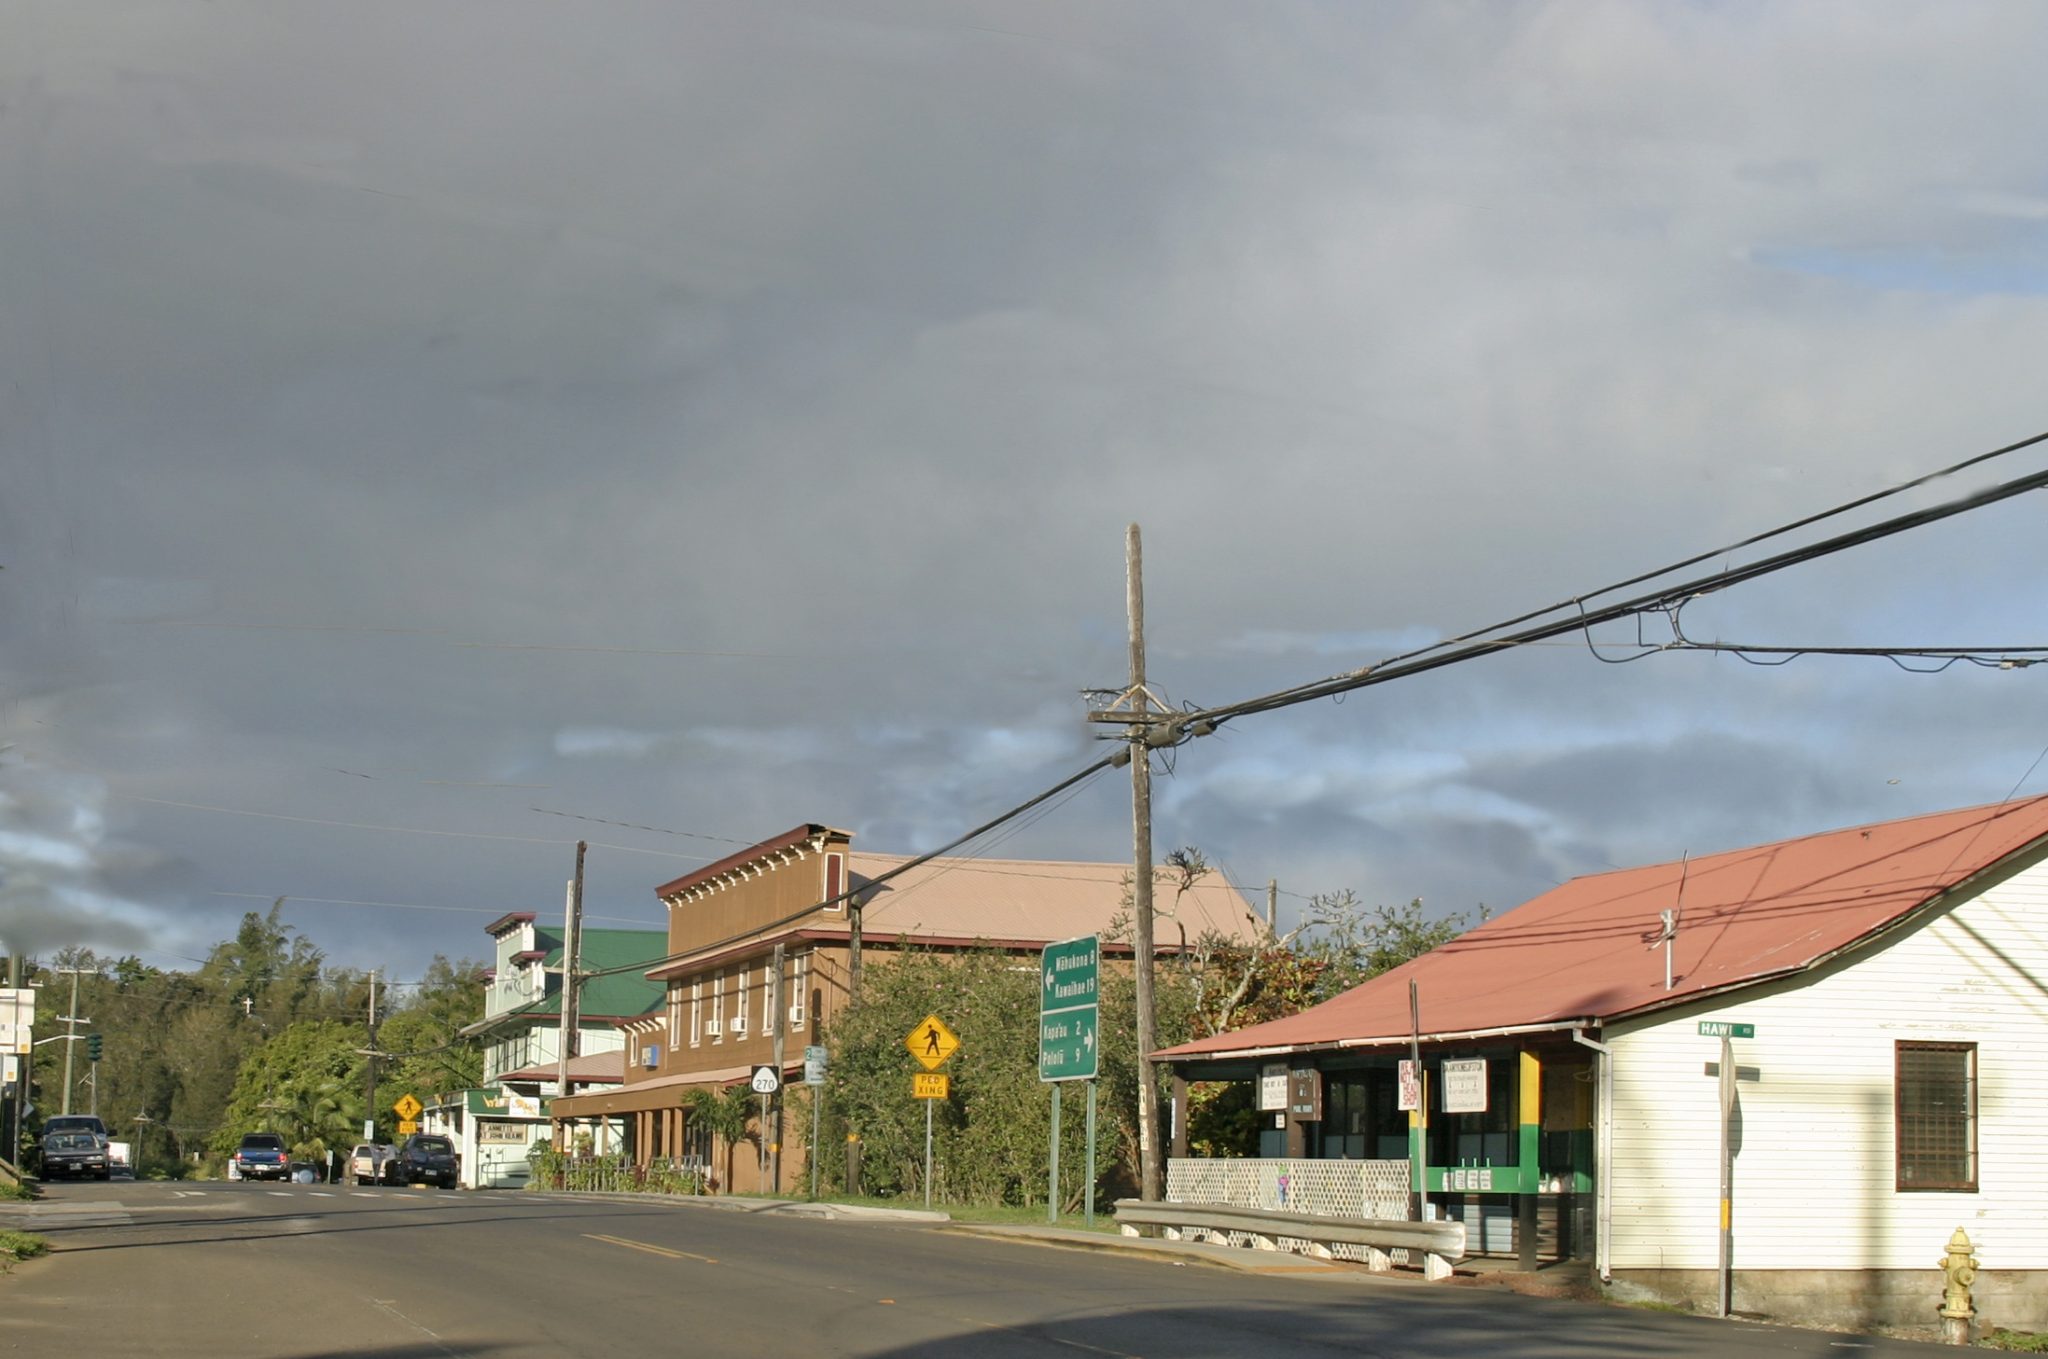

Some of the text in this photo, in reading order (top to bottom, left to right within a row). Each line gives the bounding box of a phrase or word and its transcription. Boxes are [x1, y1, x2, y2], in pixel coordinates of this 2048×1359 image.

[1055, 977, 1095, 998] Kawaihae 19
[1075, 1020, 1081, 1036] 2
[1701, 1022, 1733, 1036] HAWI
[1075, 1047, 1081, 1062] 9
[755, 1079, 775, 1090] 270
[921, 1075, 940, 1084] PED
[918, 1086, 943, 1095] XING
